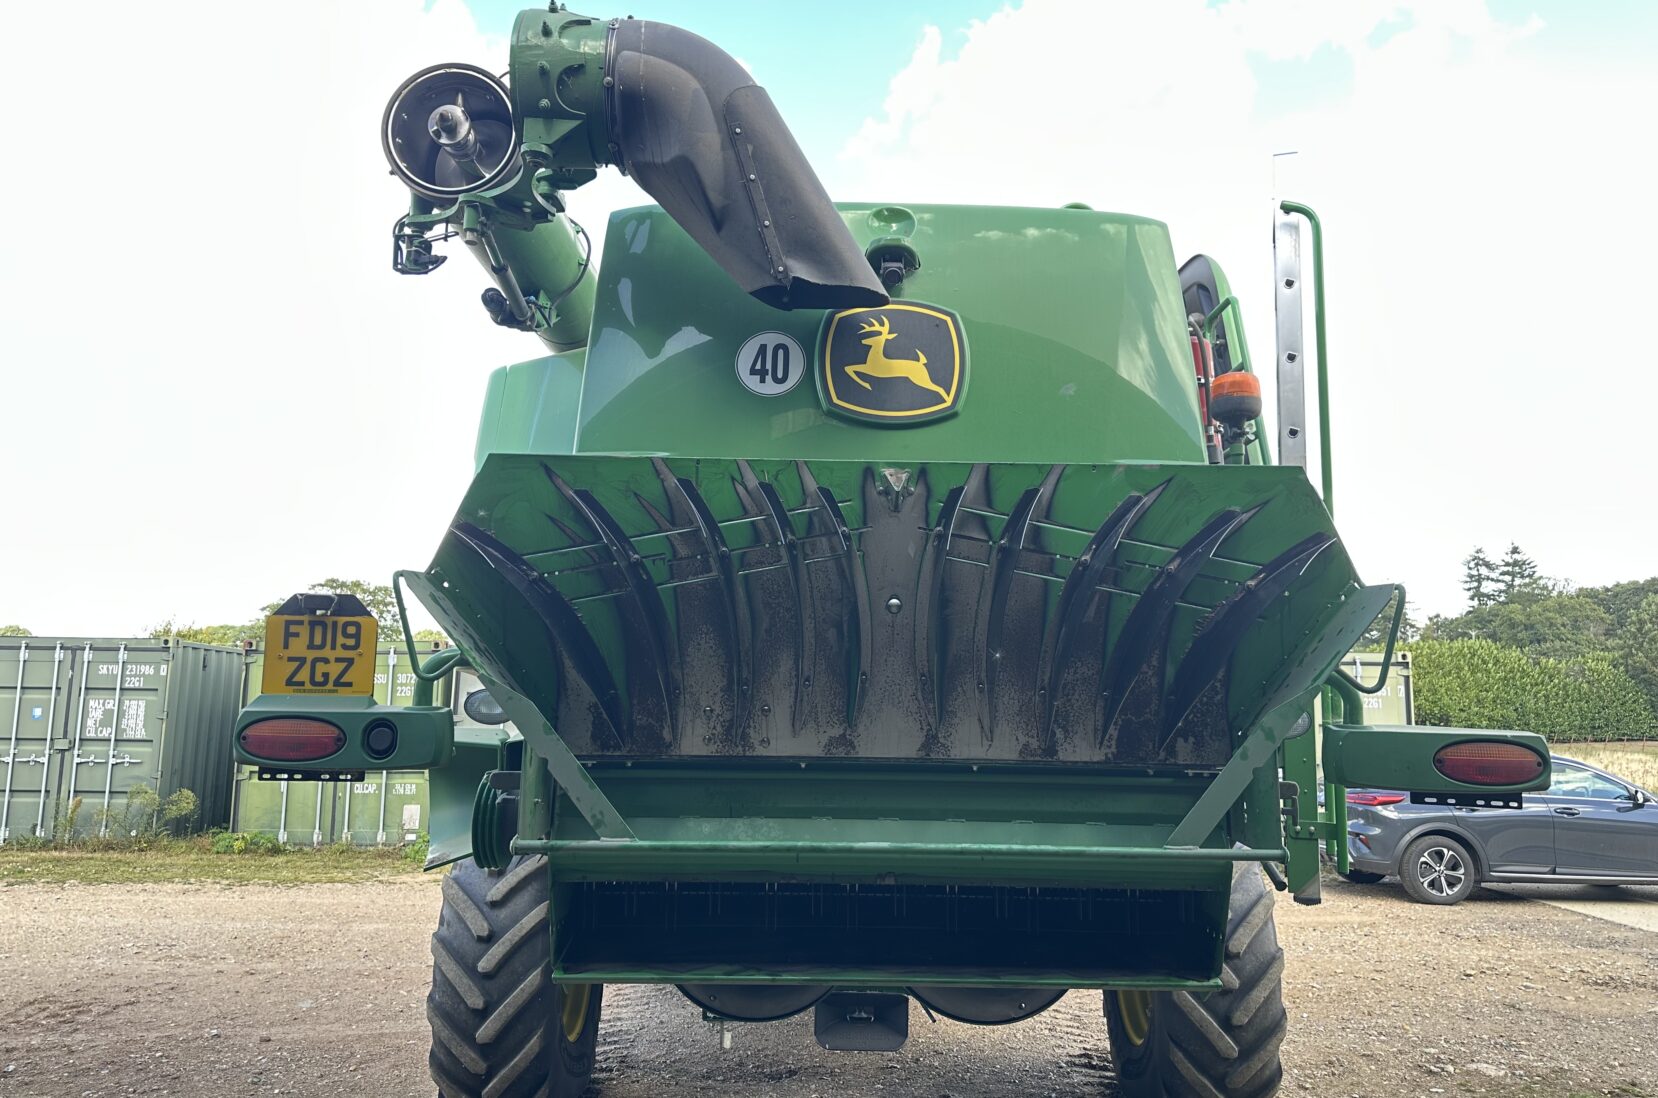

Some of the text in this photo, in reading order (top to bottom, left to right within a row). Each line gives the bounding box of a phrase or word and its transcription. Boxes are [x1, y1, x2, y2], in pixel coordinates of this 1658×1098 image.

[749, 342, 790, 385] 40
[283, 619, 362, 651] FD19
[98, 664, 118, 675] SKYU
[126, 664, 154, 675] 231986
[285, 656, 355, 688] ZGZ
[125, 677, 144, 687] 22G1
[88, 709, 104, 718] TARE
[86, 718, 100, 728] NET
